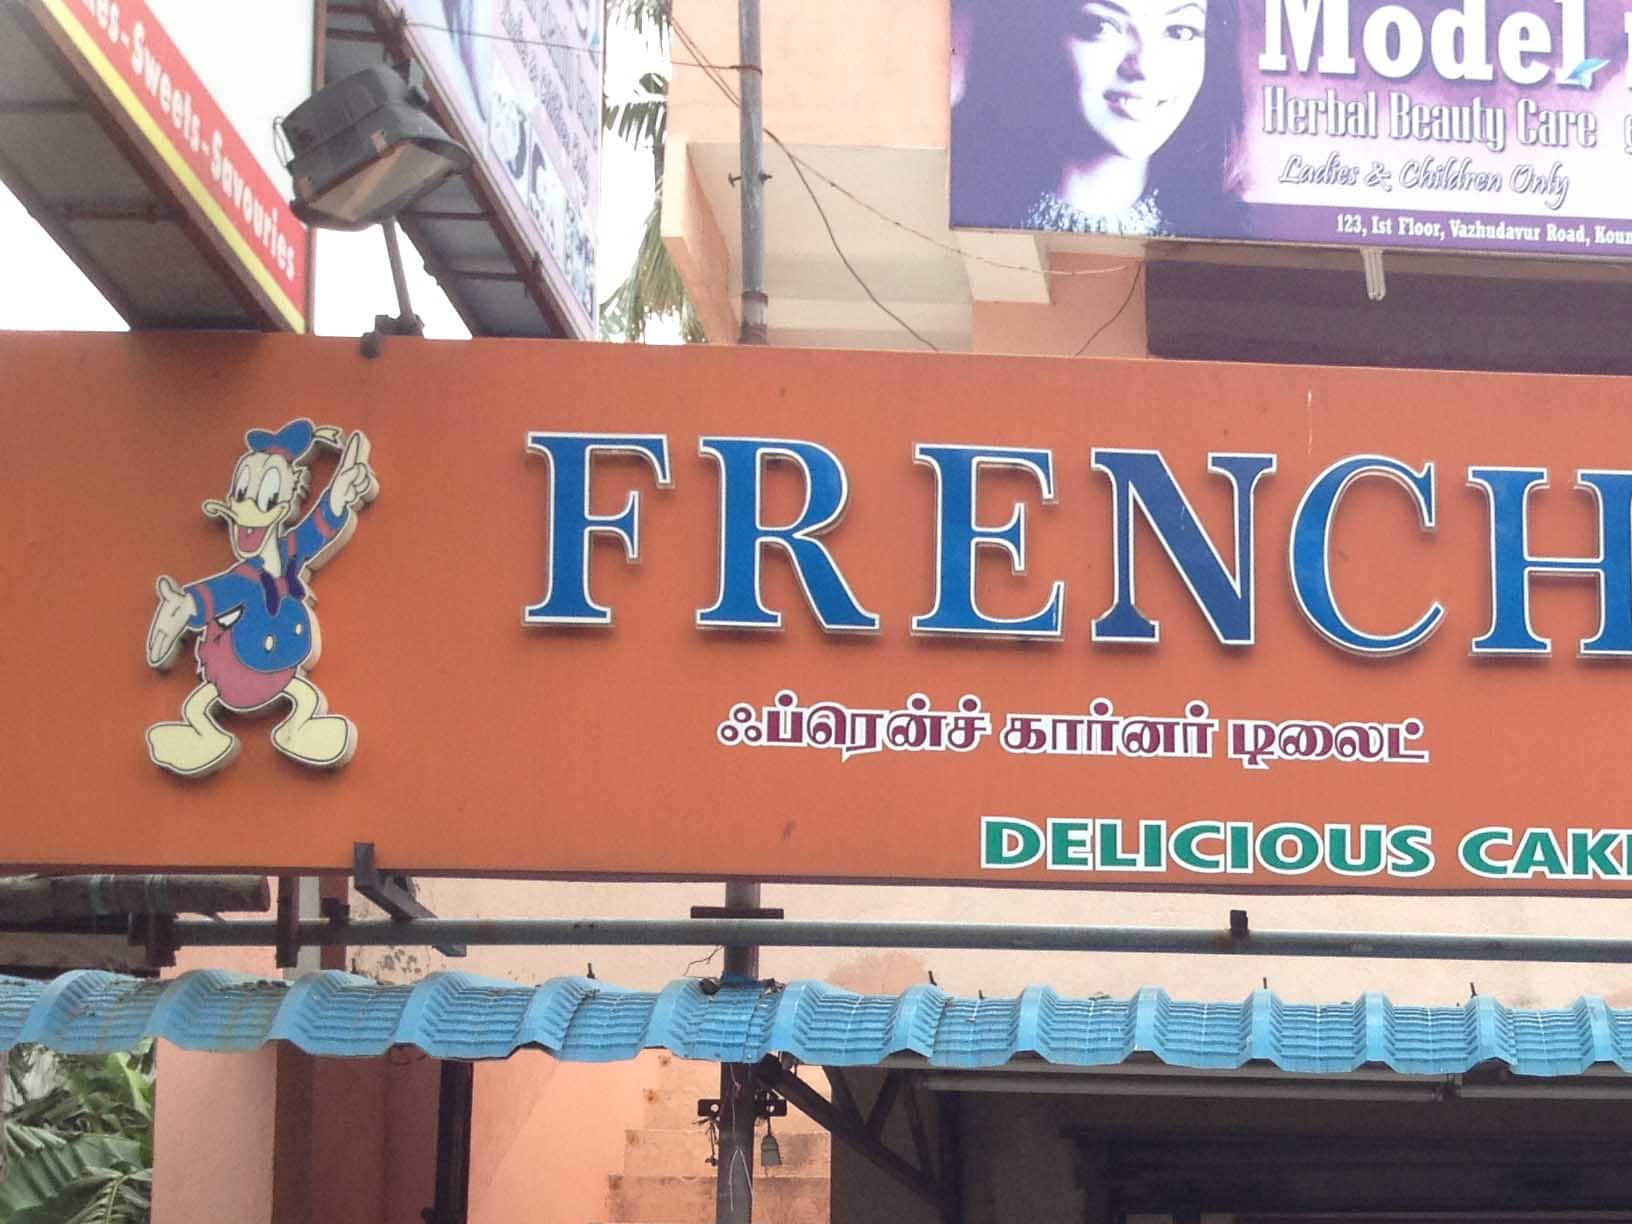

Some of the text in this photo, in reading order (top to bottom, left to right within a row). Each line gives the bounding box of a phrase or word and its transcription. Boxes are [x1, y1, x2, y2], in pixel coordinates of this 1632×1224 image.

[1258, 0, 1594, 88] Model
[1263, 85, 1598, 152] Herbal Beauty Care
[1279, 152, 1360, 187] Ladies
[1399, 158, 1502, 193] Children
[1510, 161, 1570, 210] Only
[1336, 213, 1368, 236] 123,
[1398, 217, 1445, 240] Floor,
[1449, 219, 1540, 241] Vazhudavur
[1546, 223, 1591, 247] Road,
[1000, 697, 1217, 759] கார்னர்
[1227, 717, 1430, 769] டிலைட்
[980, 816, 1435, 877] DELICIOUS
